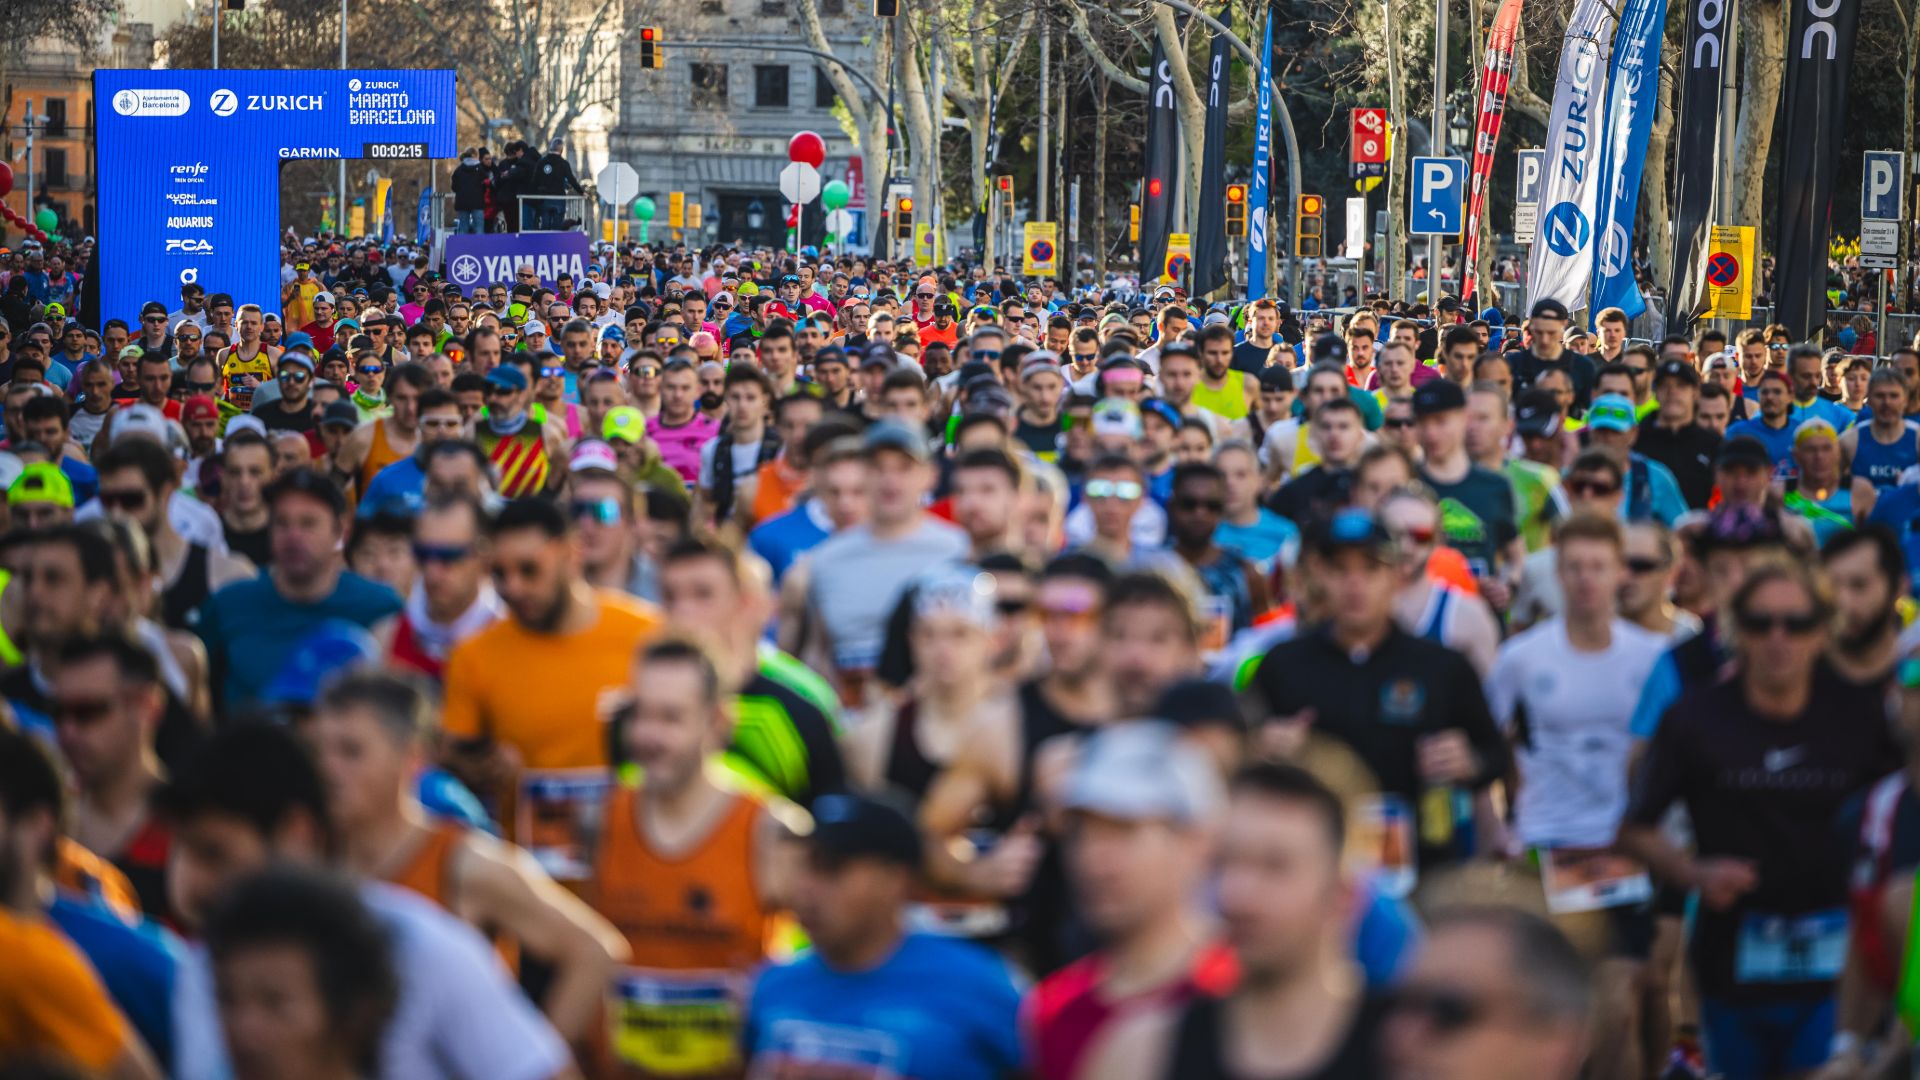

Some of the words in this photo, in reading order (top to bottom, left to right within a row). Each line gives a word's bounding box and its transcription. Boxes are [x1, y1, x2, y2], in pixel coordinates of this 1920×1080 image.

[365, 81, 399, 89] ZURICH
[247, 95, 323, 111] ZURICH
[349, 91, 408, 109] MARATÓ
[1561, 30, 1593, 185] ZURICH
[349, 109, 436, 125] BARCELONA
[278, 147, 340, 158] GARMIN
[371, 145, 423, 158] 00:02:15
[170, 161, 209, 177] renfe
[1422, 162, 1454, 203] P
[1522, 157, 1540, 199] P
[1869, 160, 1894, 212] P
[166, 216, 214, 229] AQUARIUS
[165, 238, 214, 252] FCA
[483, 254, 585, 283] YAMAHA
